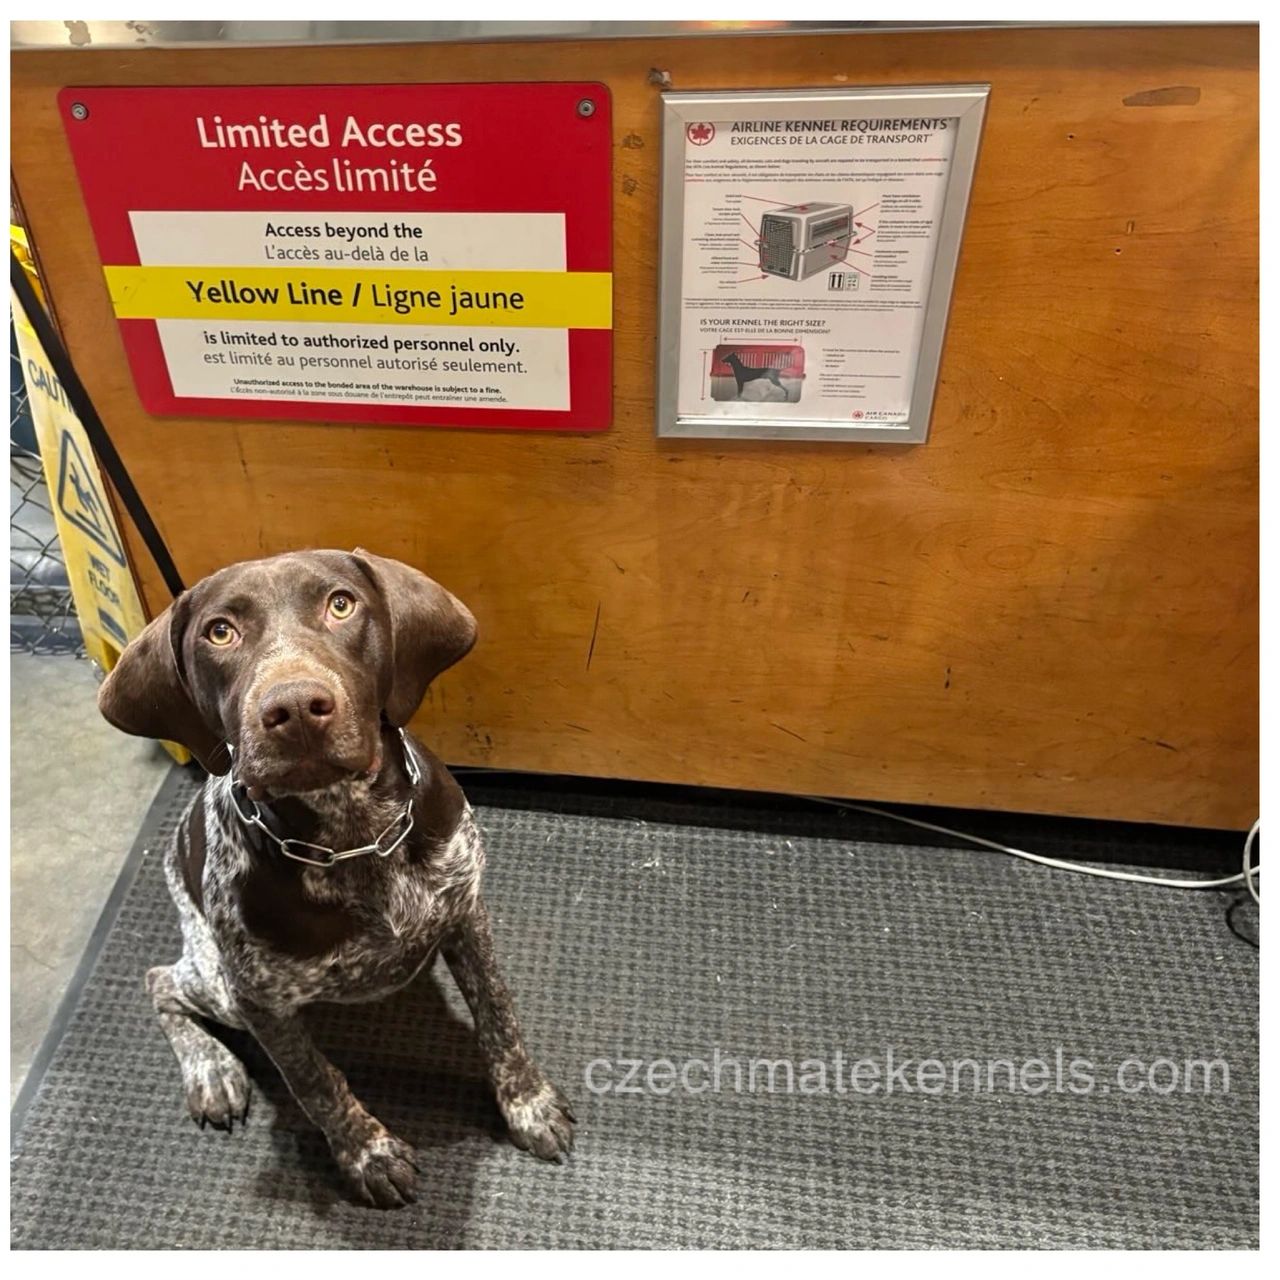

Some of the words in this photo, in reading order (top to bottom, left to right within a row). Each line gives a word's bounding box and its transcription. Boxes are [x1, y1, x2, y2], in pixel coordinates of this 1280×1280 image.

[197, 115, 329, 149] Limited
[341, 117, 463, 148] Access
[731, 121, 781, 132] AIRLINE
[785, 120, 837, 132] KENNEL
[731, 136, 786, 145] EXIGENCES
[790, 136, 803, 145] DE
[806, 136, 817, 145] LA
[820, 135, 848, 144] CAGE
[851, 135, 864, 144] DE
[239, 159, 329, 192] Accès
[334, 159, 438, 193] limité
[266, 222, 321, 238] Access
[326, 223, 389, 242] beyond
[394, 223, 423, 239] the
[266, 244, 321, 262] L'accès
[326, 244, 386, 262] au-delà
[391, 246, 410, 262] de
[414, 246, 429, 262] la
[186, 280, 279, 305] Yellow
[287, 282, 343, 307] Line
[352, 282, 363, 307] /
[372, 283, 442, 313] Ligne
[449, 285, 524, 316] jaune
[204, 331, 218, 346] is
[221, 331, 277, 348] limited
[281, 333, 299, 349] to
[303, 333, 389, 352] authorized
[394, 335, 475, 356] personnel
[479, 338, 521, 357] only.
[204, 351, 226, 366] est
[229, 349, 273, 367] limité
[277, 353, 296, 368] au
[299, 352, 374, 373] personnel
[377, 354, 438, 372] autorisé
[442, 357, 528, 375] seulement.
[395, 384, 433, 392] warehouse
[442, 386, 468, 394] subject
[87, 551, 111, 576] WET
